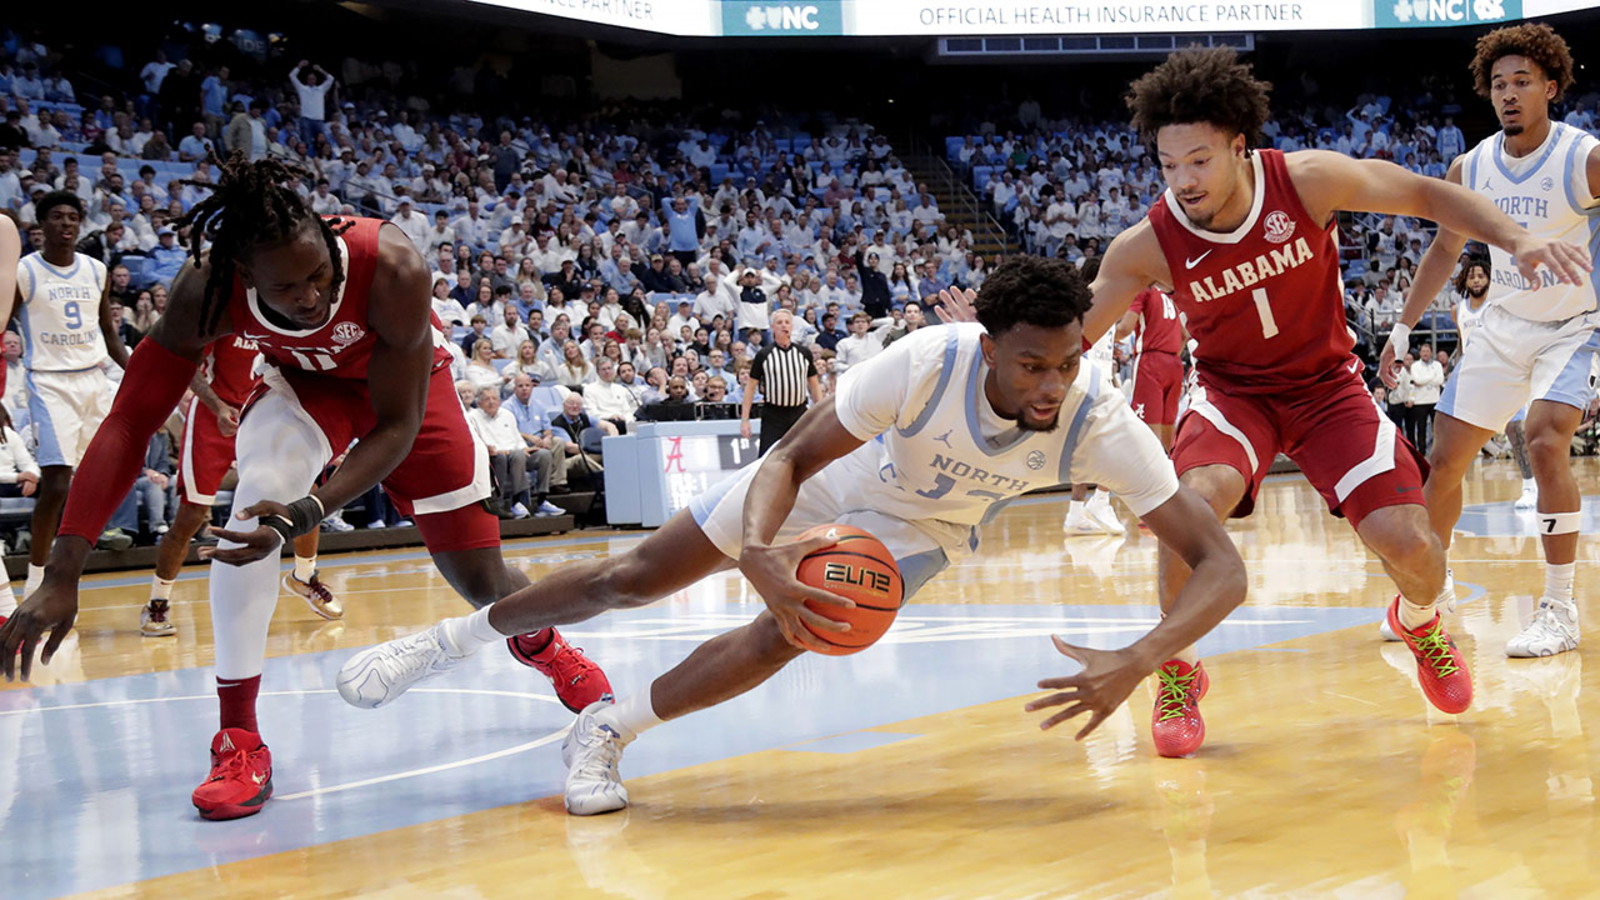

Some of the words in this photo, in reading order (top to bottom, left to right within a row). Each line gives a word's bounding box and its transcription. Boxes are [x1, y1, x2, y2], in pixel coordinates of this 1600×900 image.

[919, 7, 1008, 26] OFFICIAL
[1014, 6, 1090, 25] HEALTH
[1096, 5, 1210, 23] INSURANCE
[1216, 4, 1303, 21] PARTNER
[1190, 237, 1314, 302] ALABAMA
[49, 286, 91, 301] NORTH
[64, 301, 82, 330] 9
[1252, 287, 1279, 340] 1
[929, 453, 1030, 491] NORTH
[1542, 518, 1557, 533] 7
[824, 562, 891, 593] ELITE
